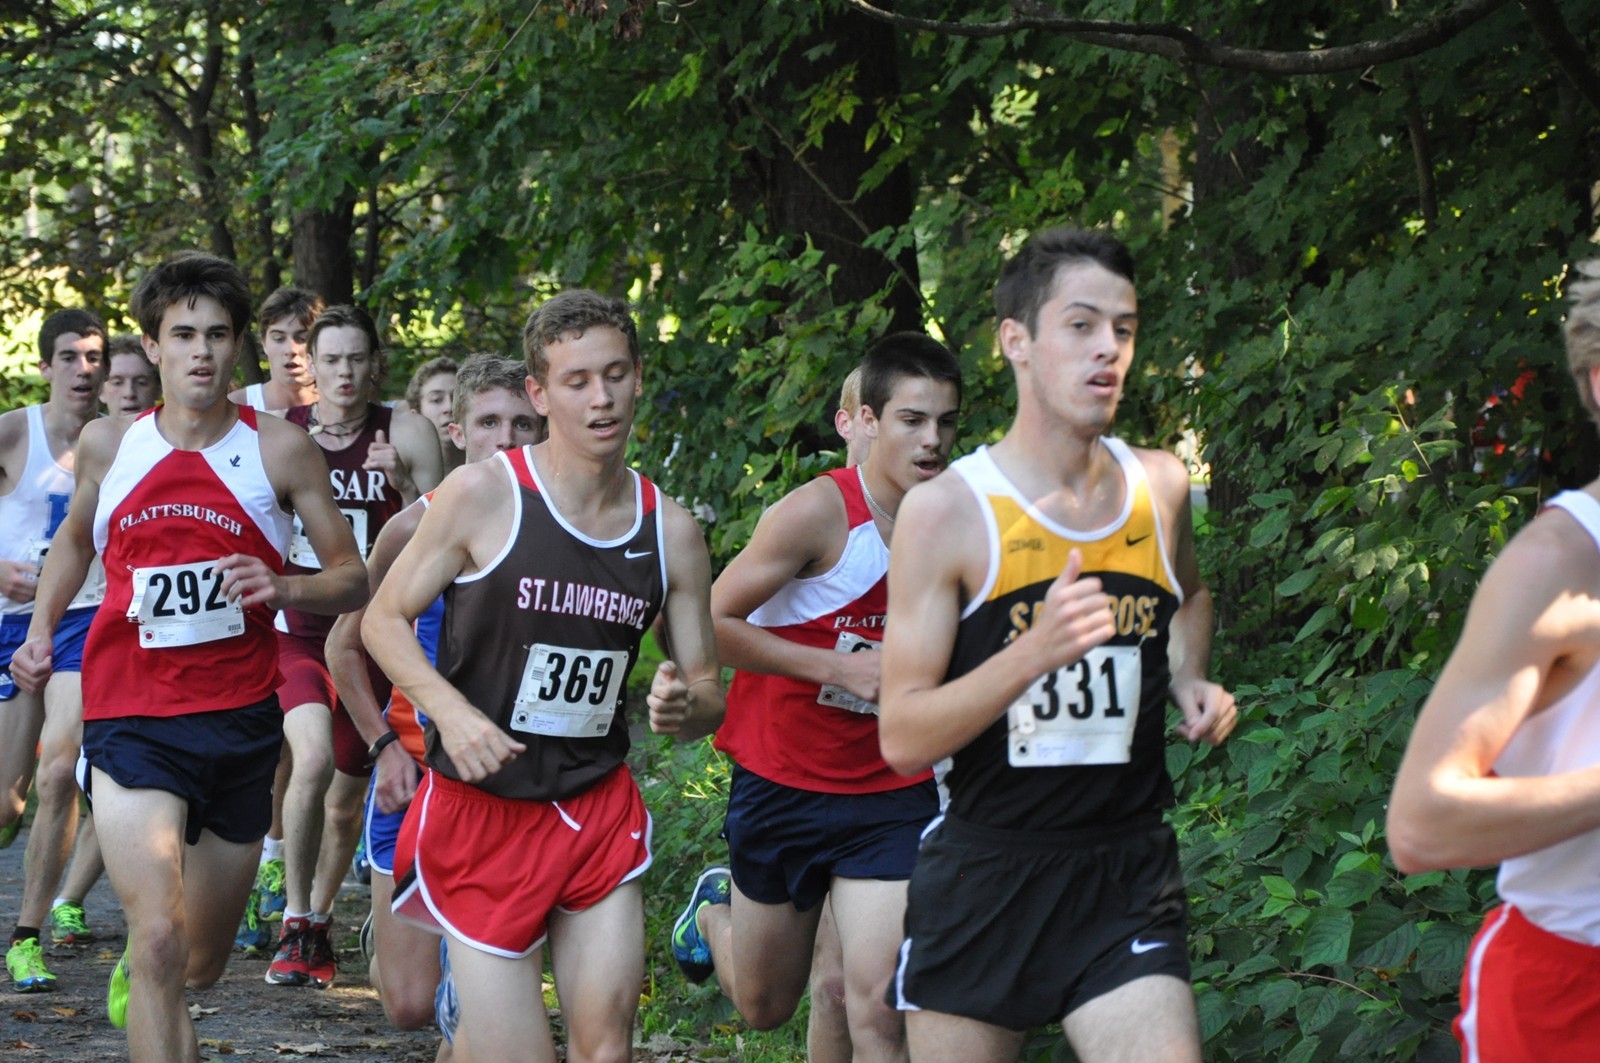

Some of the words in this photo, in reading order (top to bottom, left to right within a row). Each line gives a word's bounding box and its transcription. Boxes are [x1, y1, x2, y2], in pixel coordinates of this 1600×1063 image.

[119, 503, 242, 536] PLATTSBURGH
[148, 567, 228, 617] 292
[517, 577, 547, 611] ST.
[550, 580, 651, 629] LAWRENCE
[538, 652, 613, 705] 369
[1033, 656, 1125, 720] 331
